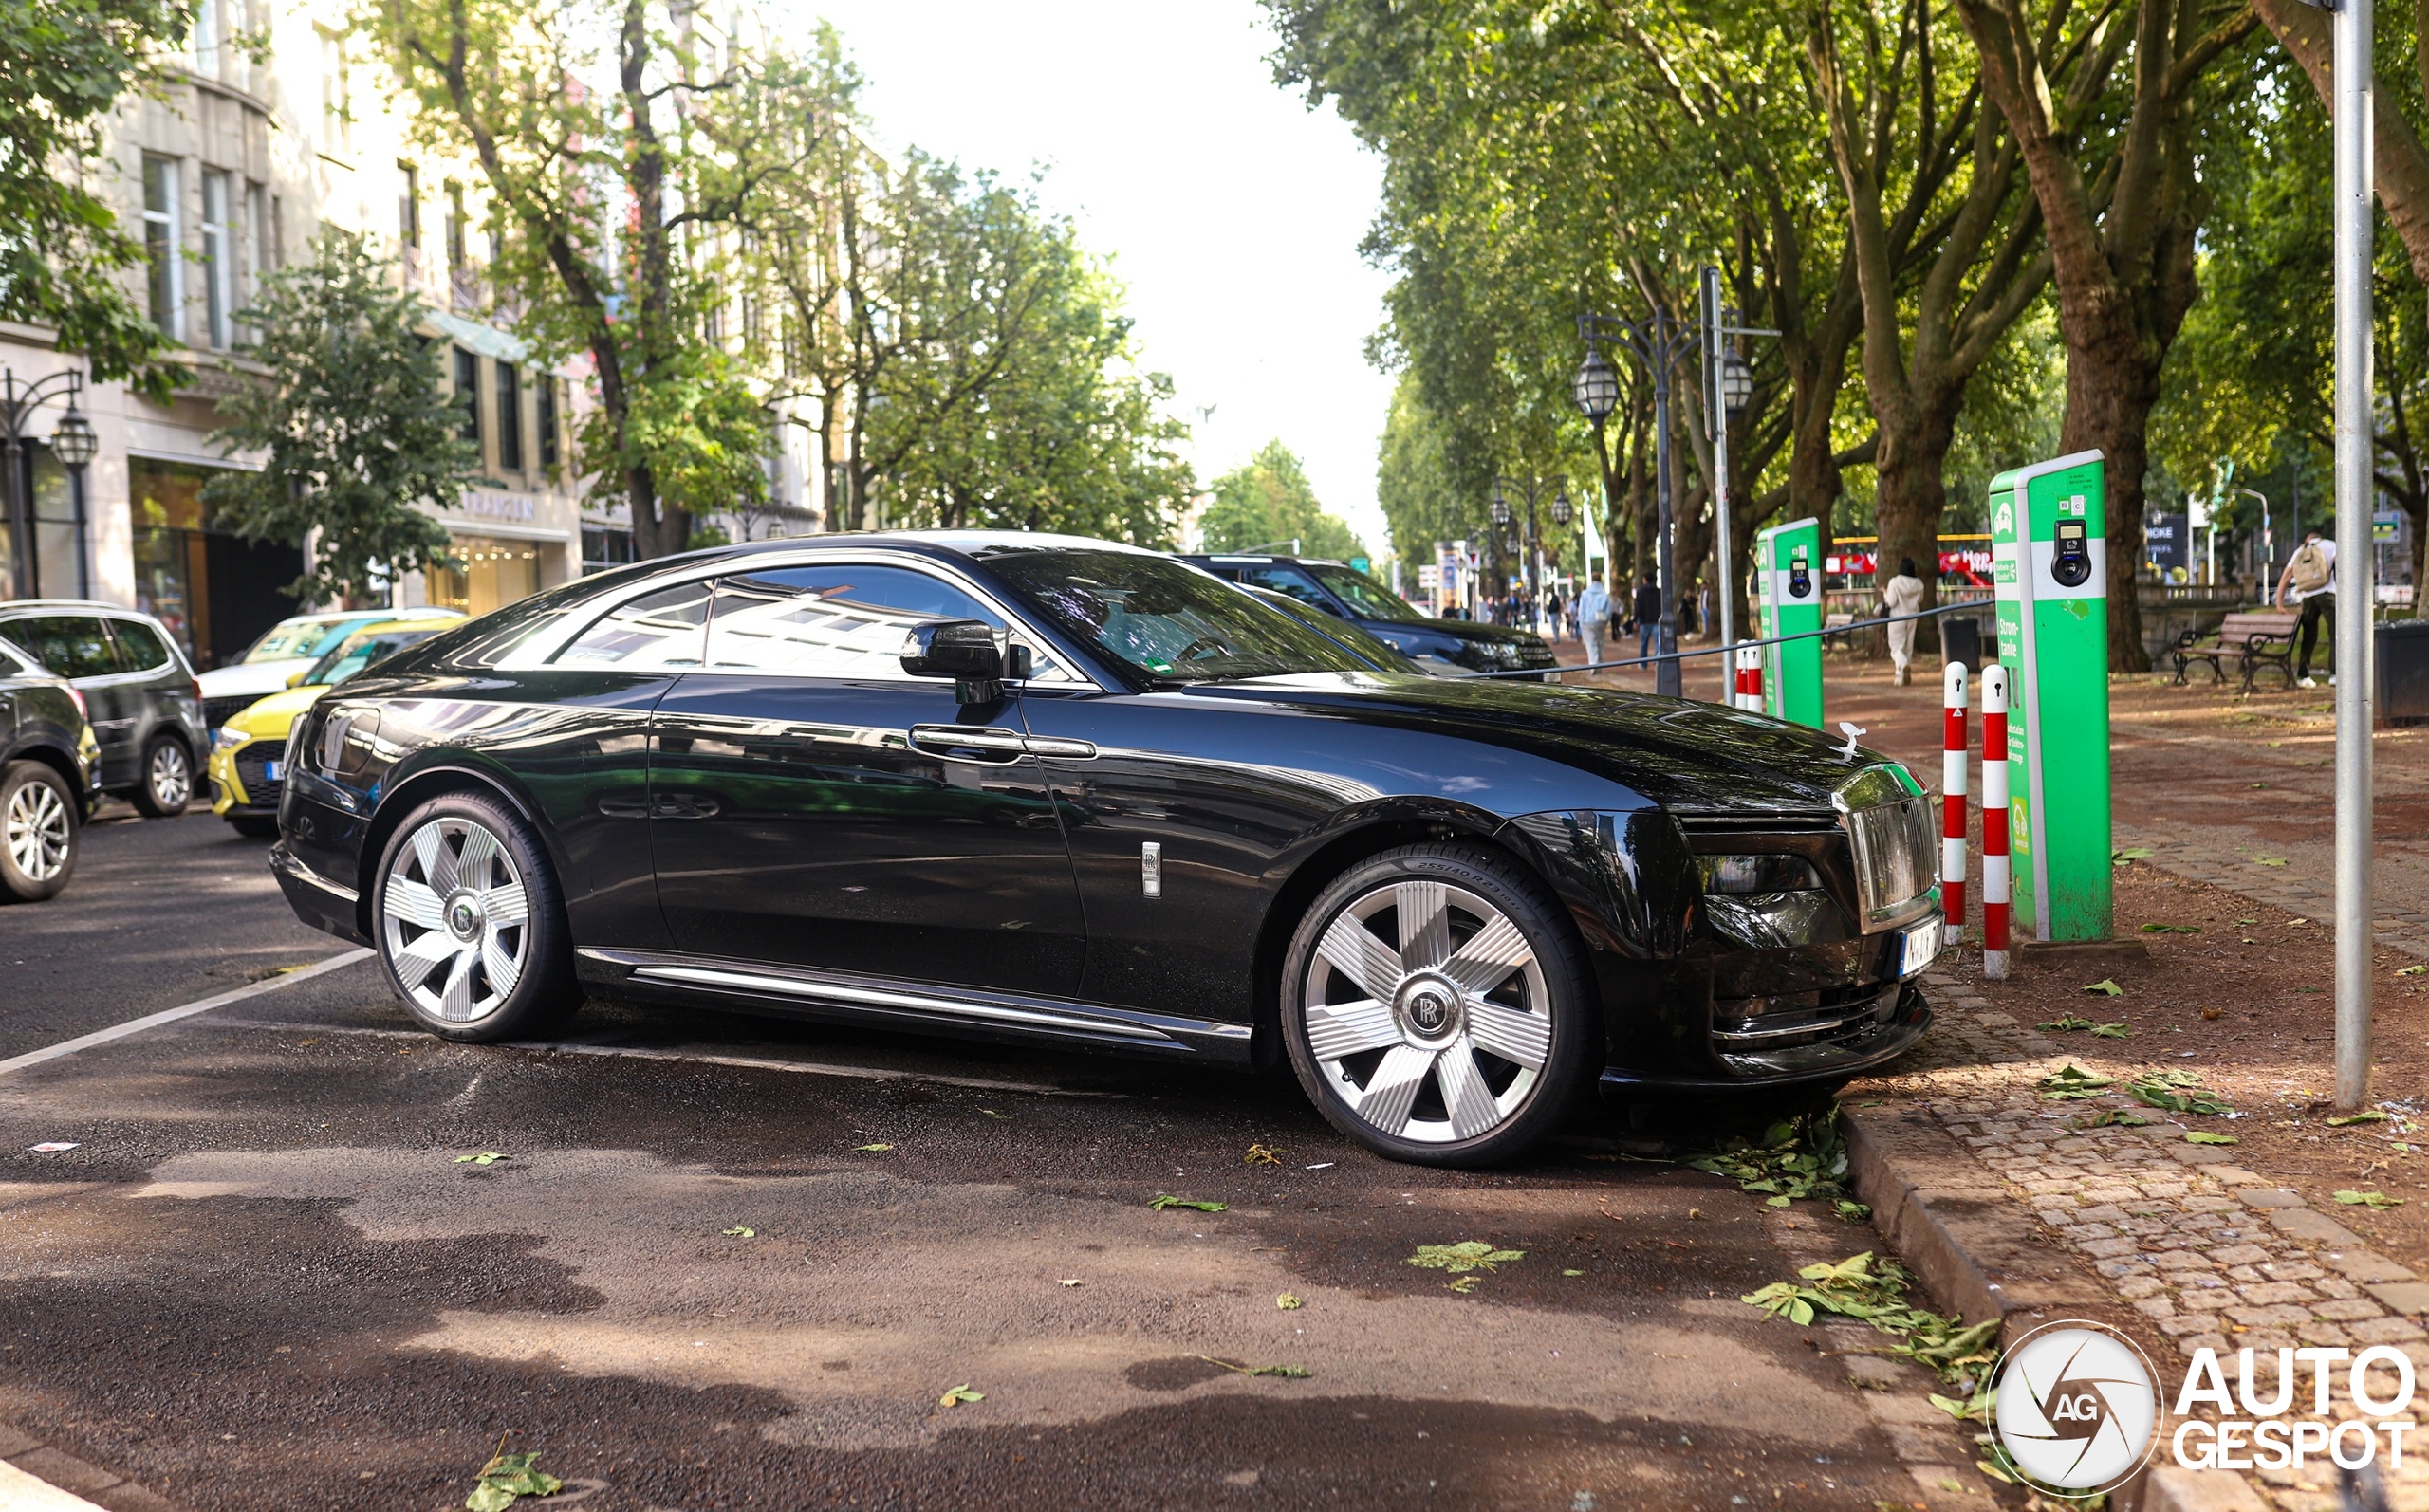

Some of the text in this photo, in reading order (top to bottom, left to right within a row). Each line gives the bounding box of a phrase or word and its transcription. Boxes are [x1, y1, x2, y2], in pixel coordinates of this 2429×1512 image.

[1999, 618, 2019, 636] Strom-
[2000, 638, 2017, 657] tanke
[1418, 862, 1470, 877] 255/40
[1472, 875, 1501, 893] R23
[1419, 998, 1438, 1023] RR
